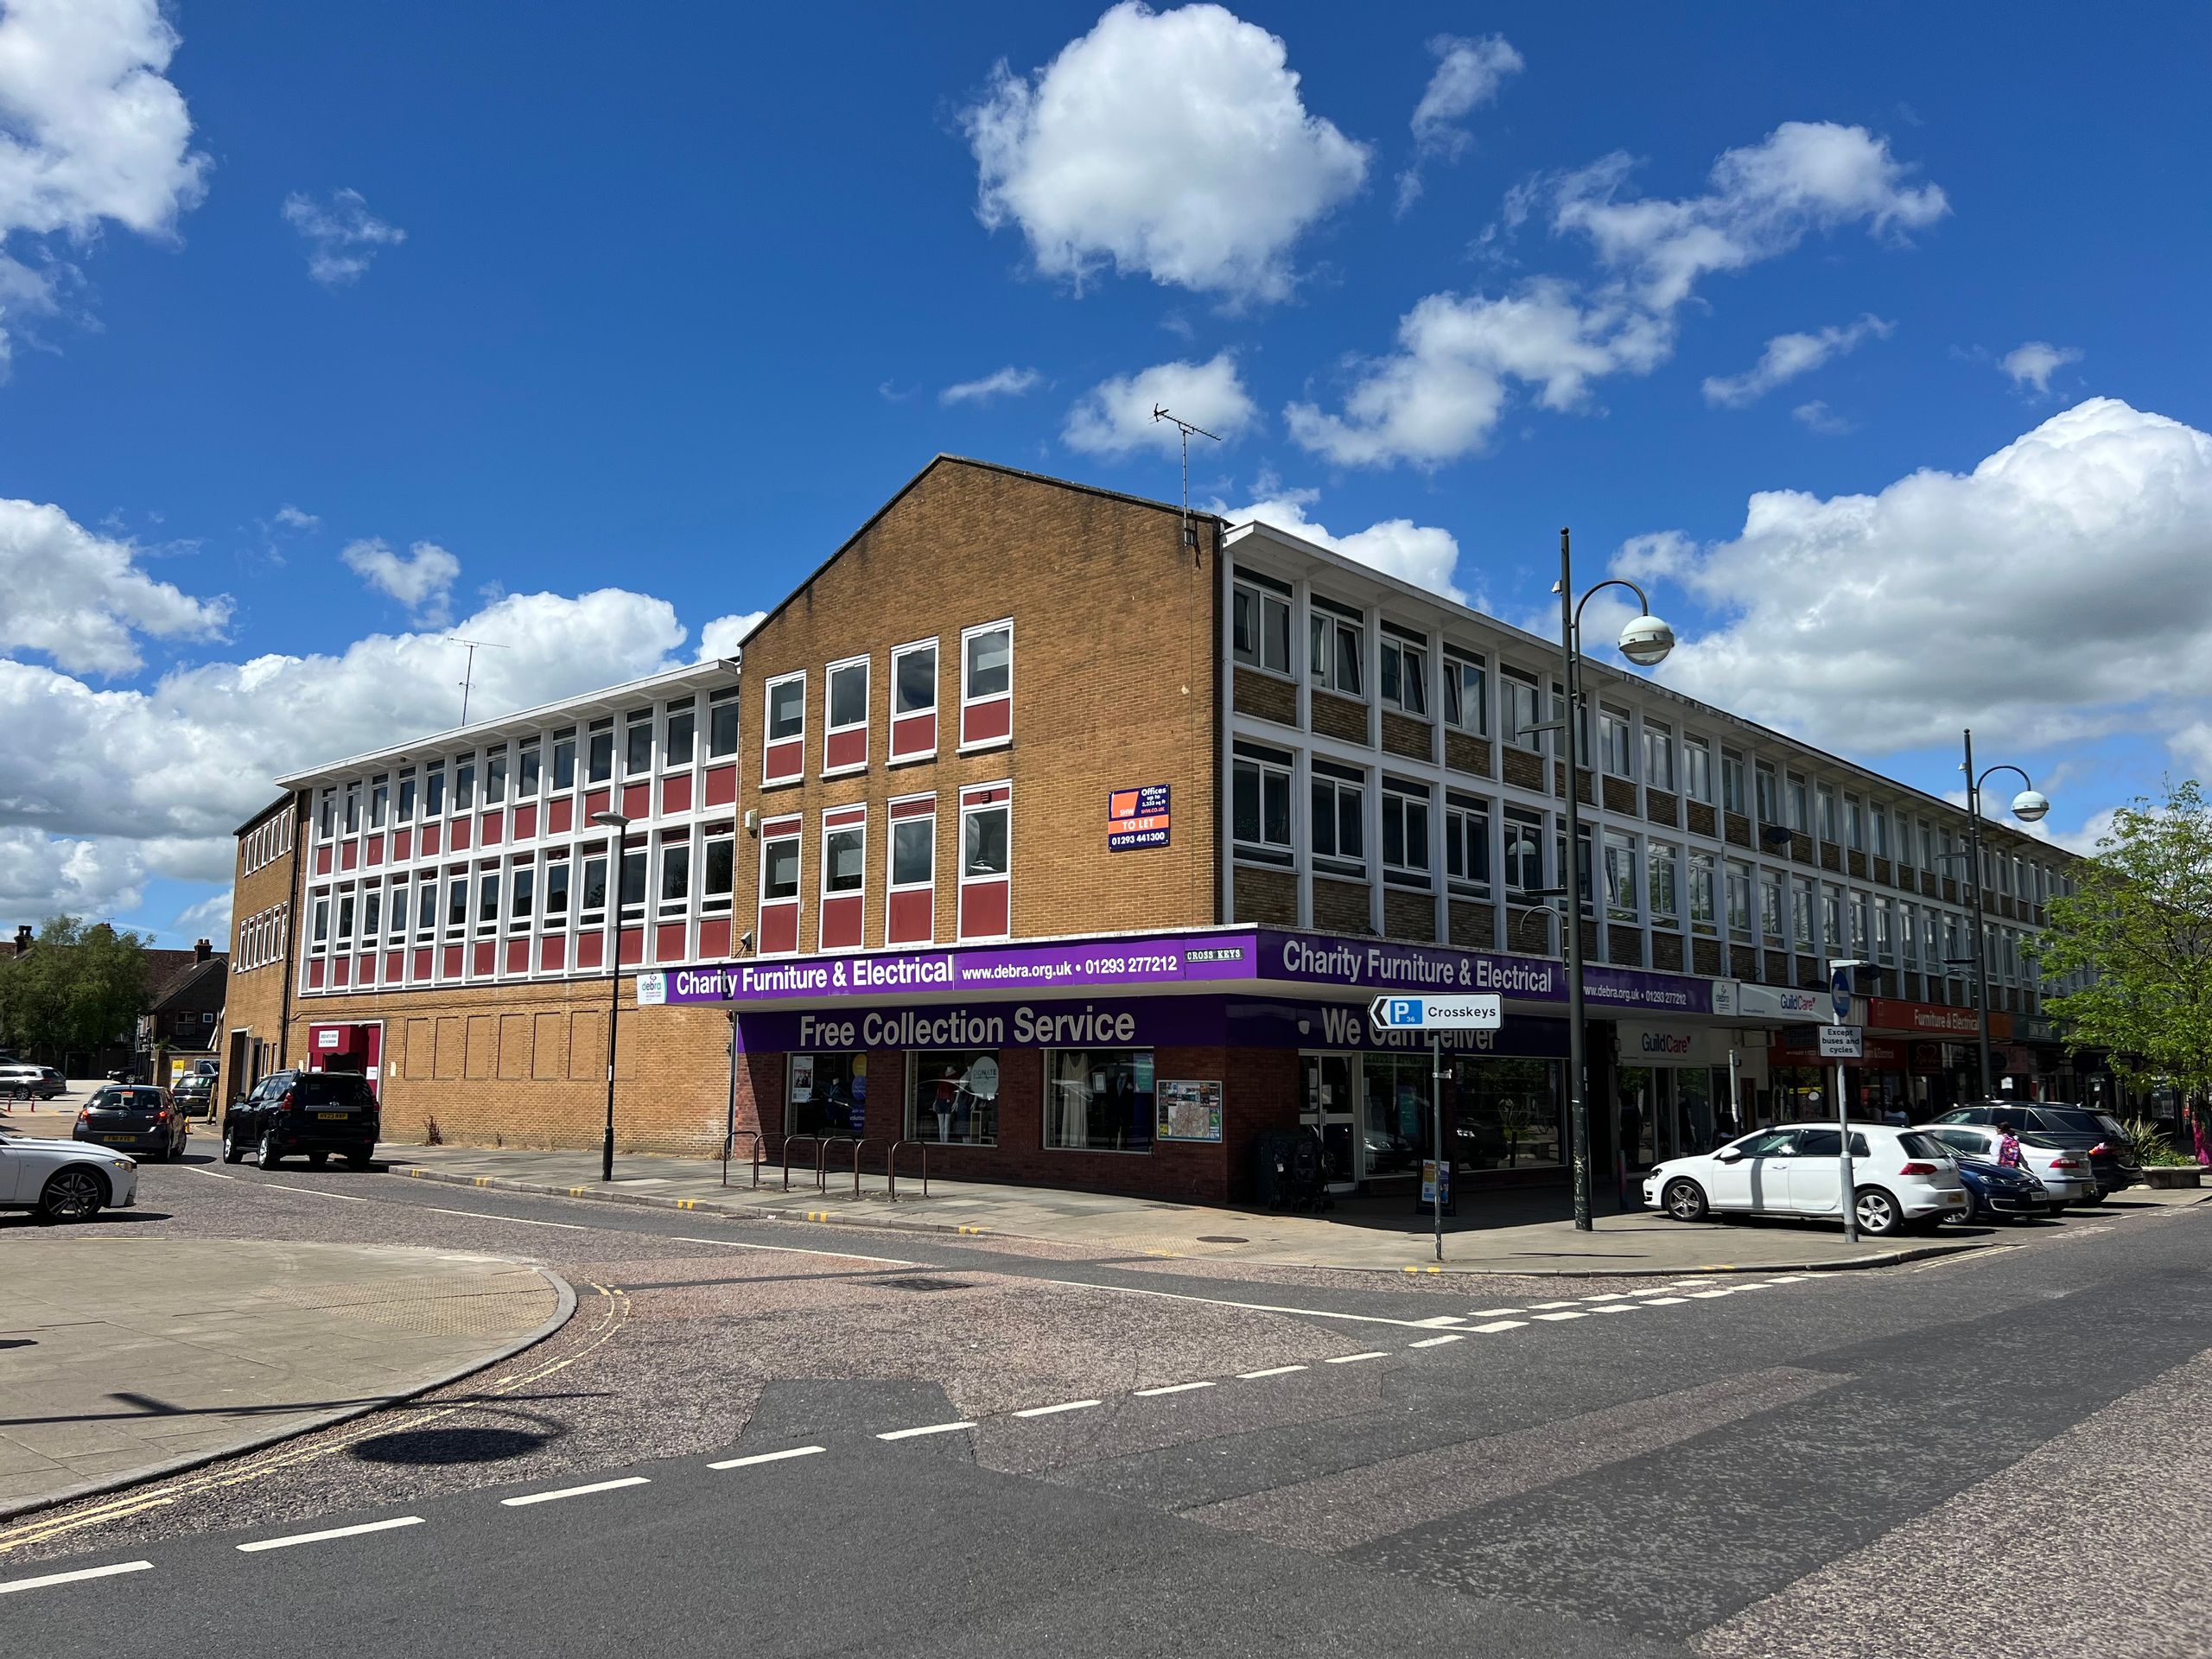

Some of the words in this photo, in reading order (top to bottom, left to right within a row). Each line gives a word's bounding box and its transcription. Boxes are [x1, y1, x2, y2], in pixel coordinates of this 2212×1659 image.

[1141, 787, 1166, 797] Offices
[1120, 808, 1135, 817] SHW
[1122, 820, 1135, 830] TO
[1138, 818, 1154, 829] LET
[1111, 835, 1135, 846] 01293
[1136, 831, 1165, 842] 441300
[1187, 950, 1213, 960] CROSS
[1217, 949, 1241, 959] KEYS
[962, 961, 1072, 980] www.debra.org.uk
[1085, 957, 1124, 975] 01293
[1128, 955, 1178, 973] 277212
[1283, 940, 1362, 982] Charity
[1368, 949, 1454, 984] Furniture
[1459, 958, 1471, 986] &
[1477, 960, 1552, 992] Electrical
[677, 969, 738, 998] Charity
[742, 965, 828, 992] Furniture
[832, 961, 848, 988] &
[853, 954, 953, 986] Electrical
[642, 981, 661, 991] debra
[1645, 990, 1664, 1003] 01293
[1665, 991, 1687, 1005] 277212
[1781, 994, 1813, 1011] GuildCare
[1394, 1001, 1409, 1023] P
[1427, 1006, 1497, 1019] Crosskeys
[1914, 1008, 1946, 1027] Furniture
[1946, 1013, 1952, 1028] &
[1952, 1013, 1980, 1031] Electrical
[800, 1015, 855, 1047] Free
[864, 1009, 1004, 1046] Collection
[1014, 1005, 1135, 1043] Service
[1321, 1007, 1362, 1045] We
[1827, 1028, 1853, 1037] Except
[1642, 1032, 1688, 1053] GuildCare
